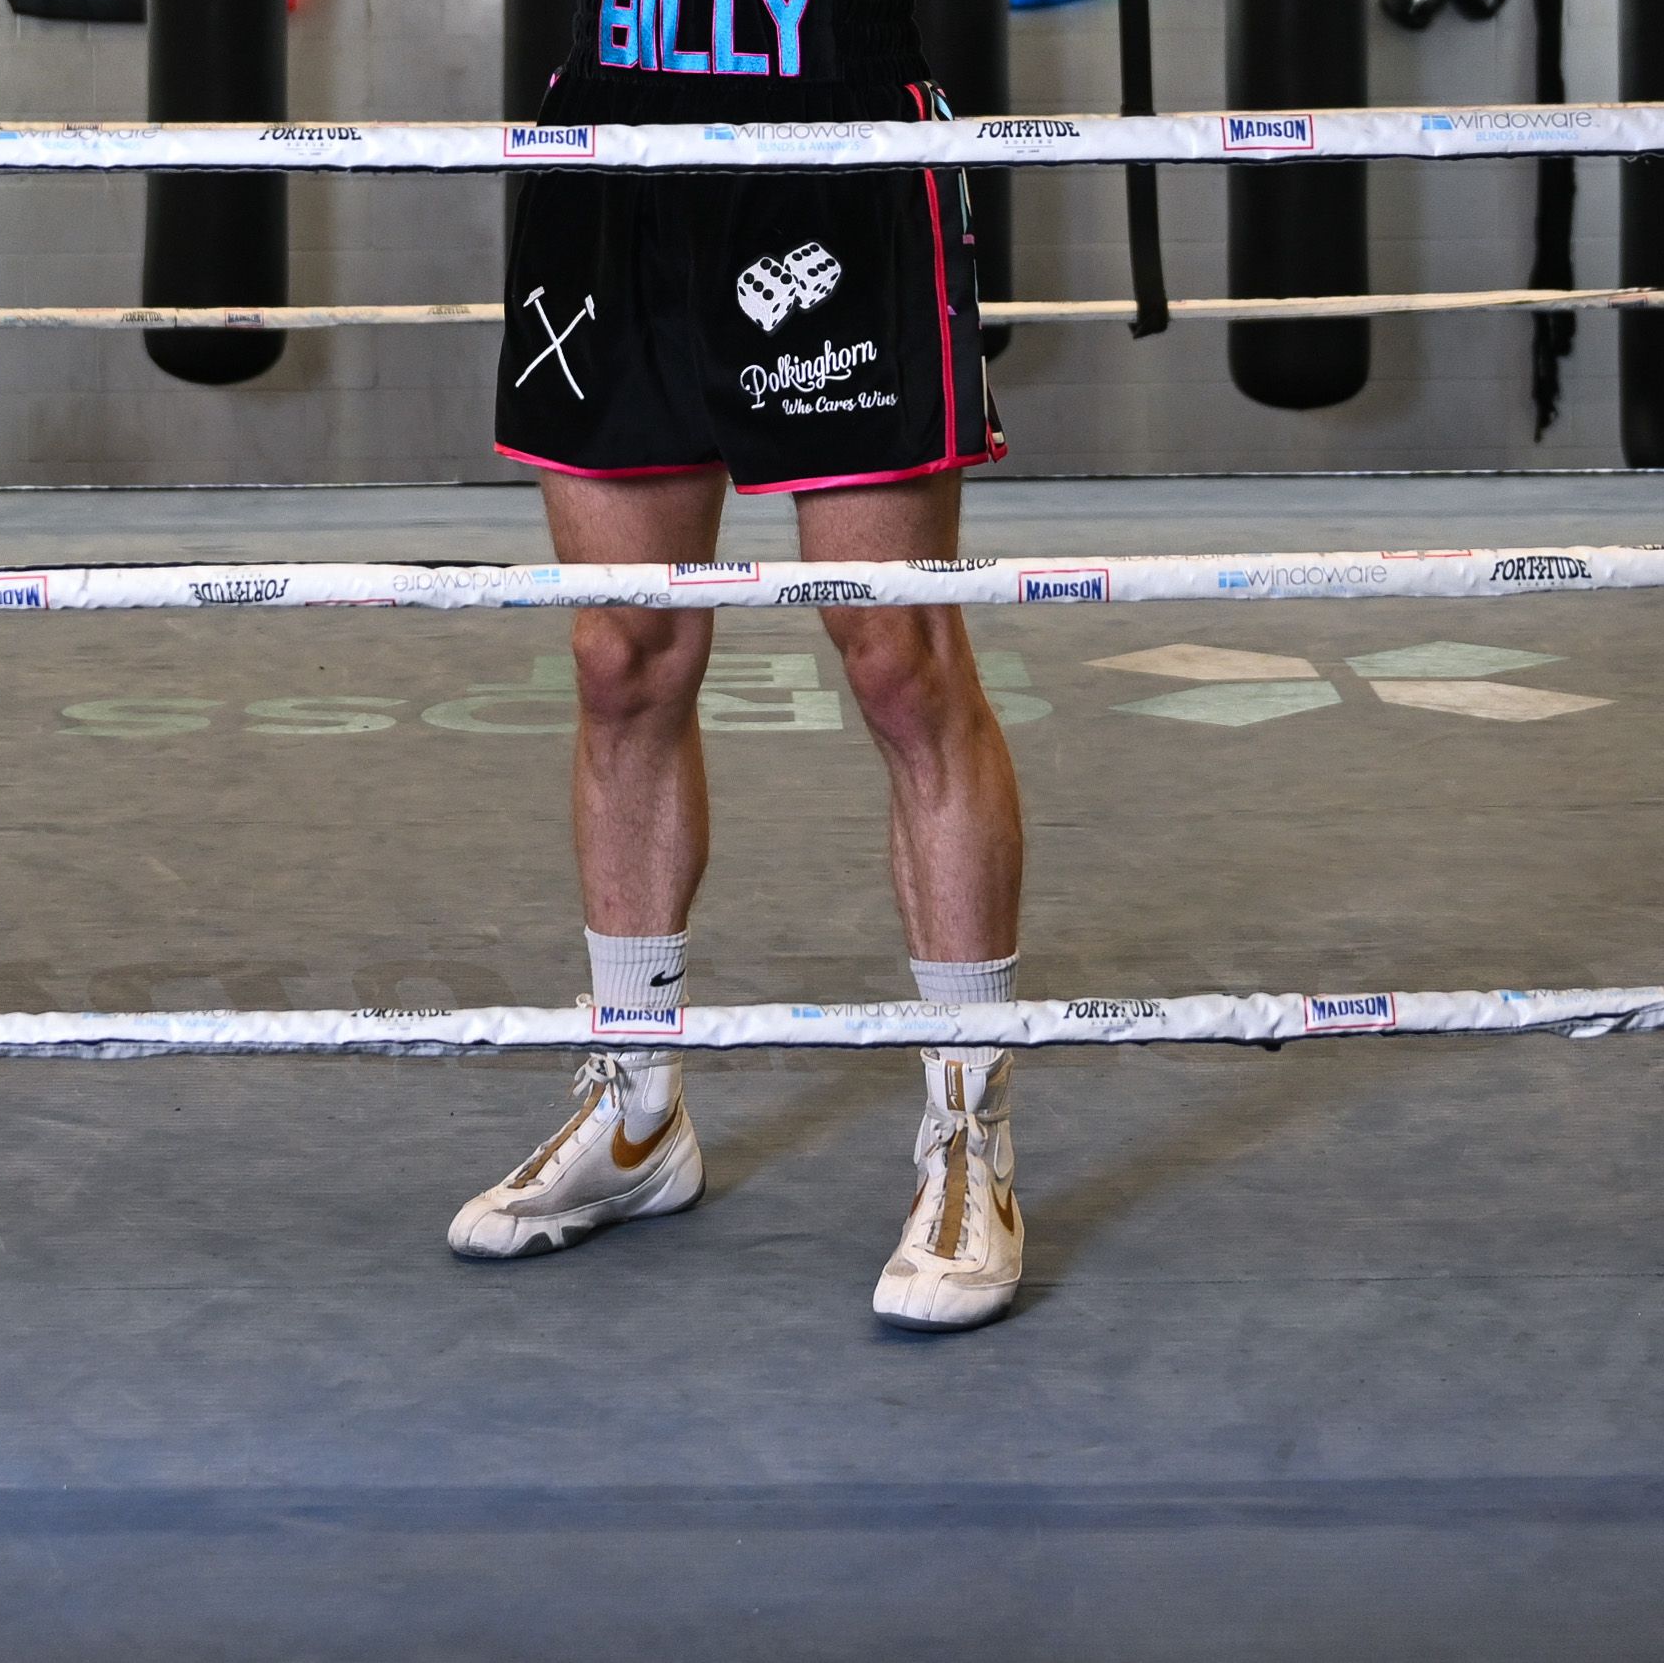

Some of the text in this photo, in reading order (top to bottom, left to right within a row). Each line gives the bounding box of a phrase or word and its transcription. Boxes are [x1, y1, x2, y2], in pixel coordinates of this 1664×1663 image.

[735, 120, 873, 141] windoware
[976, 121, 1079, 139] FORTITUDE
[1230, 117, 1306, 142] MADISON
[1453, 110, 1591, 131] windoware
[512, 128, 588, 150] MADISON
[1475, 133, 1514, 142] BLINDS
[1528, 131, 1579, 141] AWNINGS
[740, 339, 877, 410] Polkinghorn
[782, 390, 899, 416] Who Cares Wins
[1245, 561, 1386, 586] windoware
[1490, 556, 1591, 582] FORTITUDE
[777, 581, 876, 603] FORTITUDE
[1025, 577, 1102, 601] MADISON
[600, 1006, 675, 1025] MADISON
[1312, 997, 1388, 1020] MADISON
